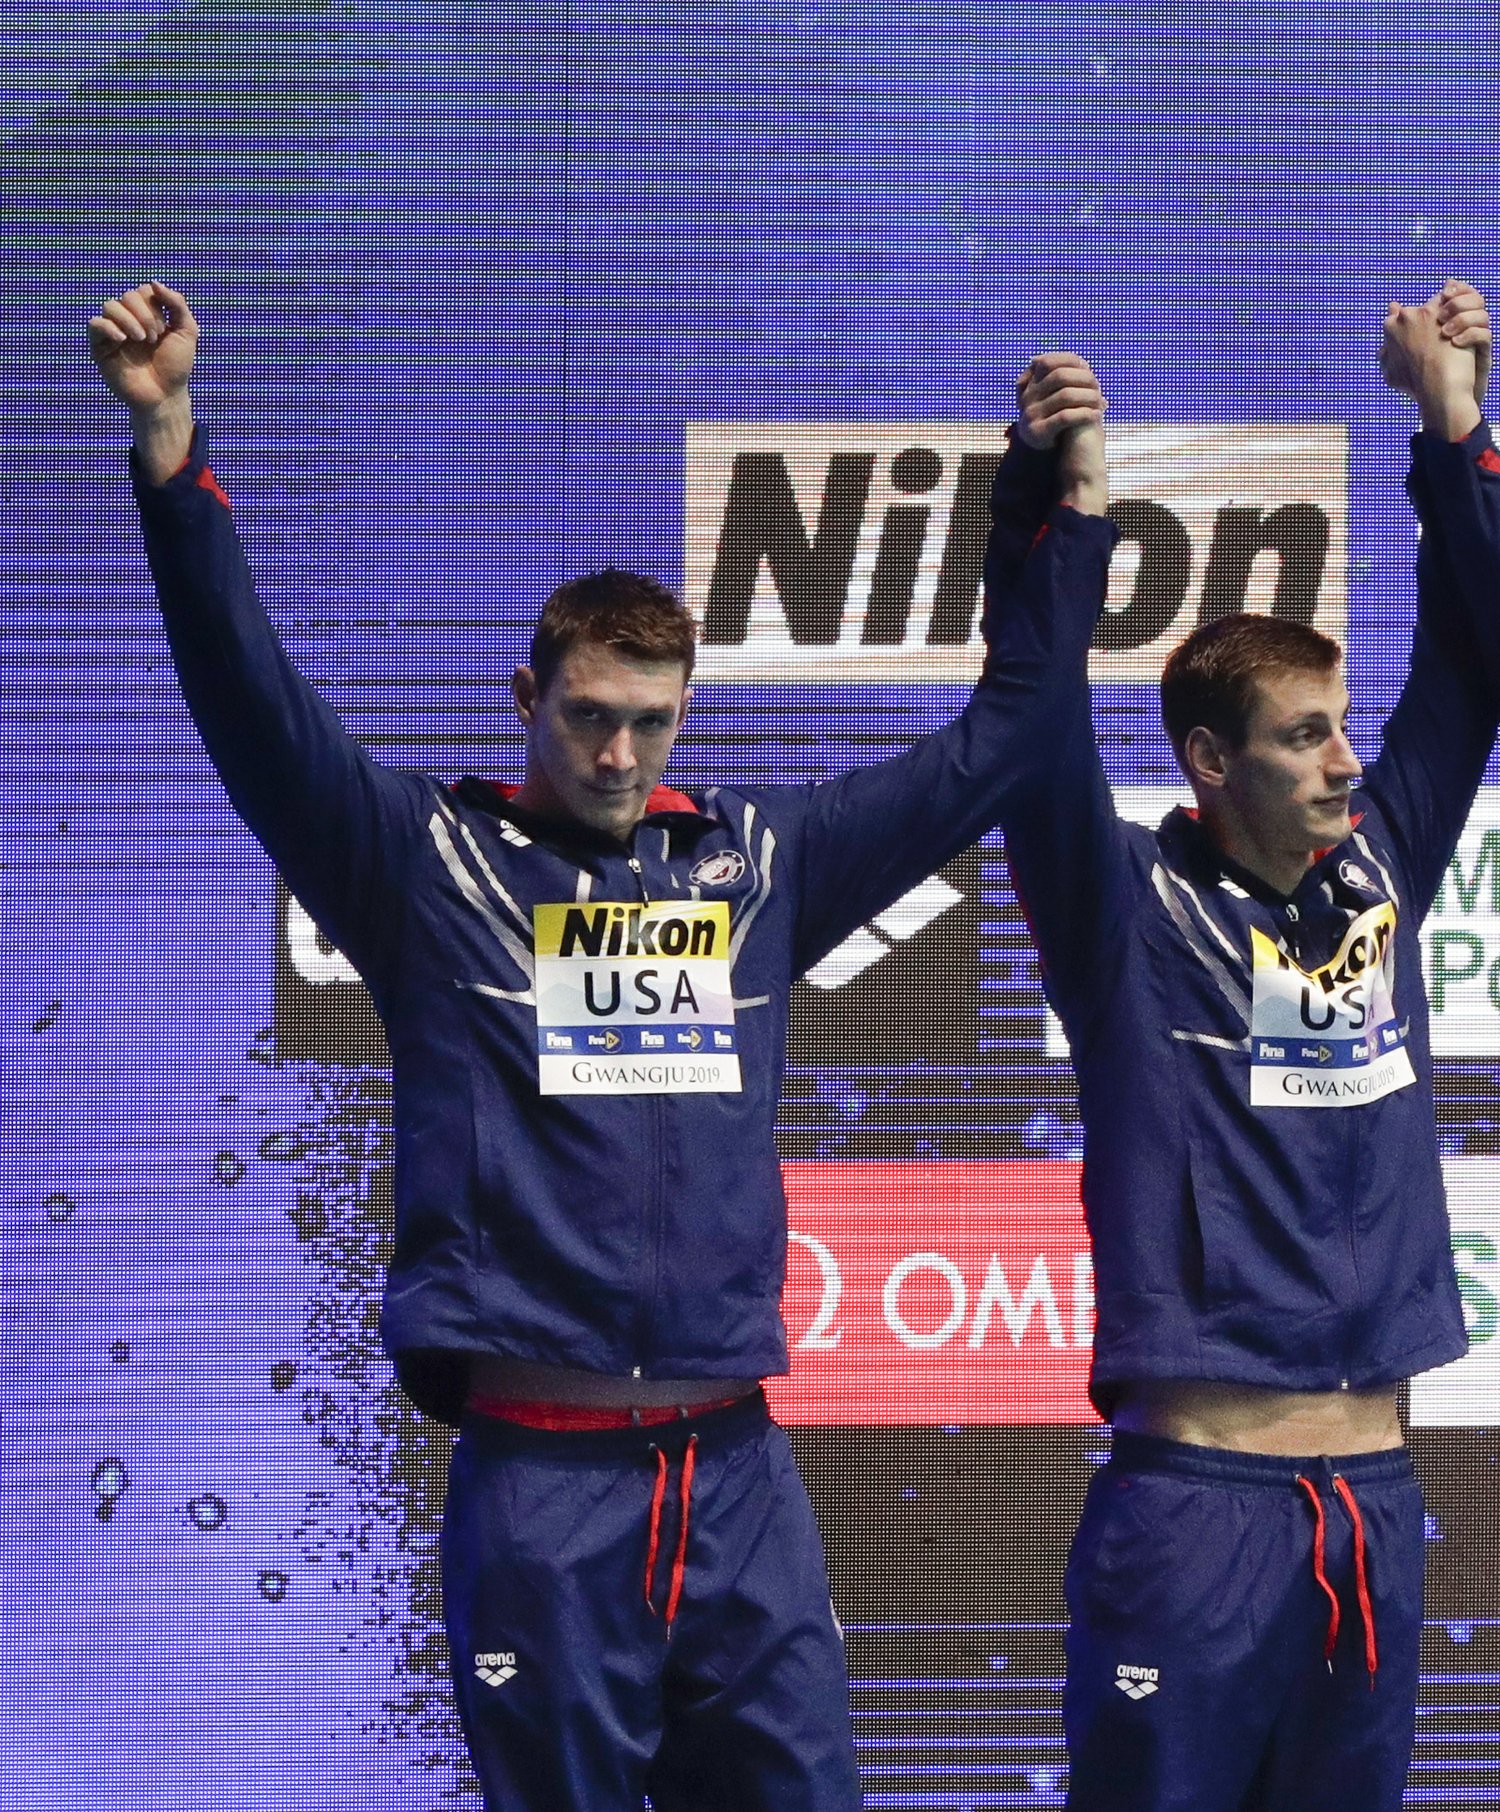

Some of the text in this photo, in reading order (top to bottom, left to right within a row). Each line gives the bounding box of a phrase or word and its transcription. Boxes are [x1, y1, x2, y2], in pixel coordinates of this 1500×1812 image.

[559, 907, 716, 958] Nikon
[584, 969, 700, 1017] USA
[1301, 984, 1374, 1031] US
[688, 1066, 721, 1084] 2019
[474, 1652, 516, 1667] arena
[1116, 1664, 1159, 1682] arena
